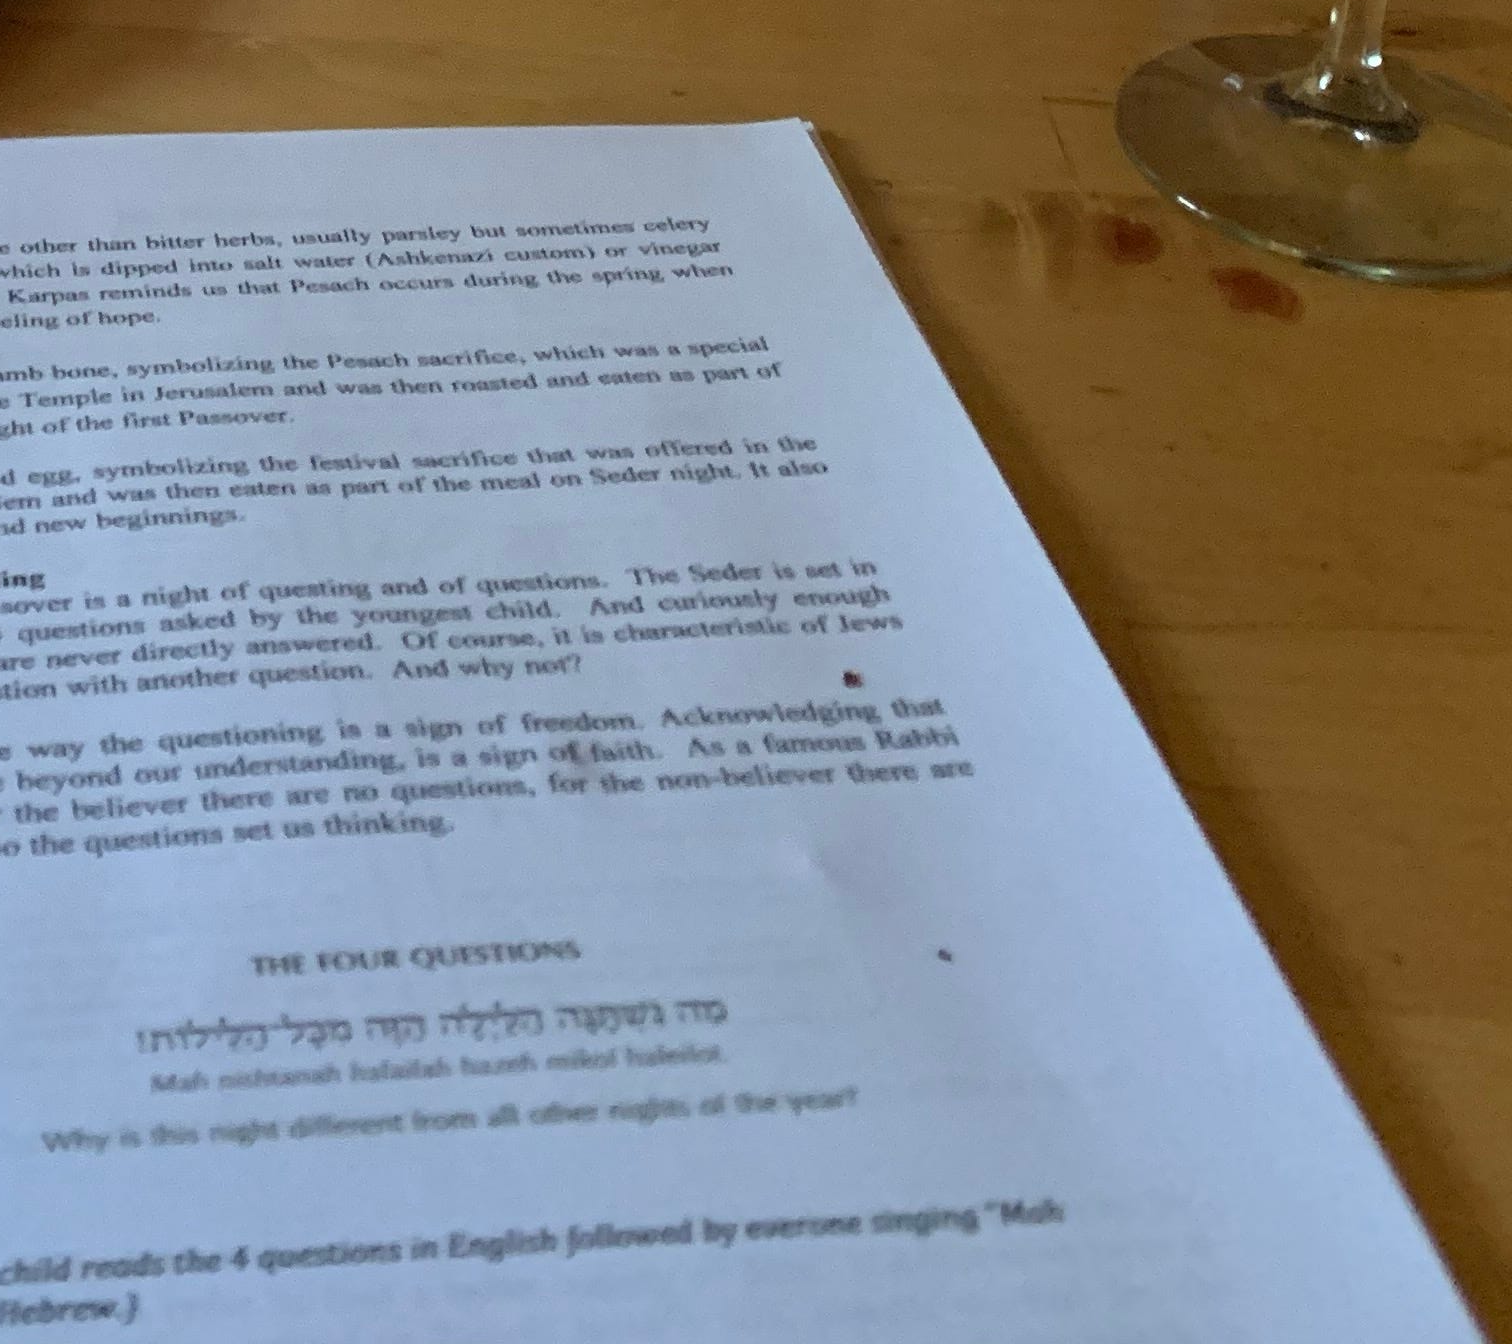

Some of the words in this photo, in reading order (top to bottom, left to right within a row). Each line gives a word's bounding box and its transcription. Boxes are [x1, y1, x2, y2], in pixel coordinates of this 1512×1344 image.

[20, 238, 78, 255] other
[88, 237, 137, 253] than
[145, 234, 205, 251] bitter
[214, 232, 282, 249] herbs,
[292, 227, 371, 246] usually
[381, 226, 461, 245] parsley
[470, 223, 506, 239] but
[515, 219, 635, 238] sometimes
[643, 216, 709, 234] celery
[83, 591, 106, 611] is
[115, 593, 132, 609] a
[141, 584, 210, 610] night
[220, 580, 251, 602] of
[258, 578, 372, 604] questing
[380, 576, 430, 597] and
[438, 574, 467, 596] of
[475, 573, 608, 597] questions.
[625, 564, 680, 587] The
[688, 561, 763, 584] Seder
[771, 560, 797, 582] is
[805, 561, 843, 580] set
[849, 557, 878, 578] in
[26, 740, 85, 764] way
[99, 732, 145, 757] the
[157, 722, 326, 755] questioning
[336, 717, 362, 741] is
[374, 721, 393, 740] a
[403, 717, 464, 743] sign
[476, 711, 508, 737] of
[520, 710, 645, 734] freedom.
[661, 700, 883, 729] Acknowledging
[890, 696, 947, 720] that
[29, 830, 76, 857] the
[81, 825, 224, 857] questions
[232, 819, 275, 844] set
[280, 818, 316, 840] us
[321, 810, 454, 838] thinking.
[247, 951, 306, 978] THE
[314, 946, 402, 973] FOUR
[408, 939, 584, 971] QUESTIONS
